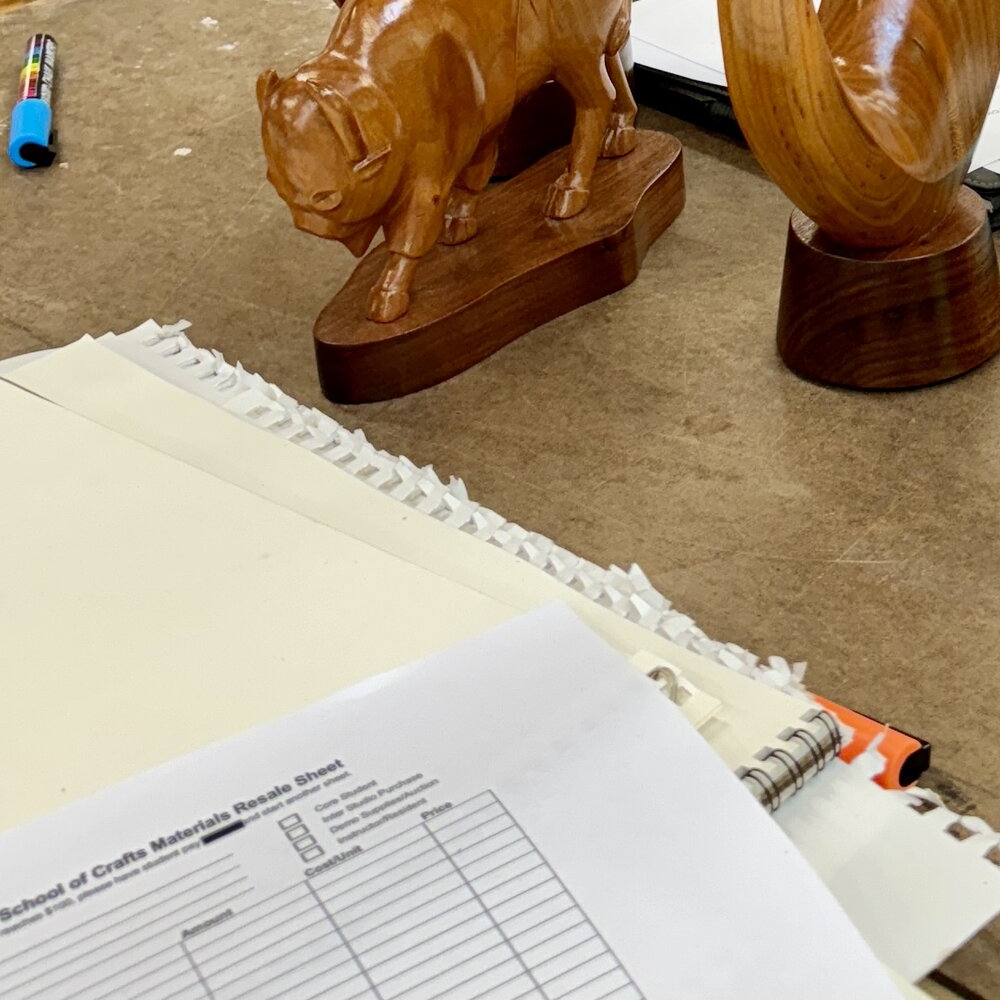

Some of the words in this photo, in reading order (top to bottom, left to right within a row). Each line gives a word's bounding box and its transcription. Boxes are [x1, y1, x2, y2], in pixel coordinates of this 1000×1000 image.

[314, 797, 340, 814] Core
[339, 779, 379, 801] Student
[321, 808, 345, 824] Inter
[346, 792, 378, 813] Studio
[378, 772, 424, 798] Purchase
[329, 815, 360, 835] Demo
[361, 777, 440, 820] Supplies/Auction
[420, 801, 454, 821] Price
[337, 796, 428, 845] Instructor/Resident
[0, 883, 66, 922] School
[68, 871, 89, 890] of
[91, 848, 149, 879] Crafts
[149, 808, 232, 853] Materials
[232, 783, 293, 815] Resale
[294, 758, 345, 787] Sheet
[142, 848, 181, 872] student
[304, 844, 364, 878] Cost/Unit
[182, 908, 234, 939] Amount
